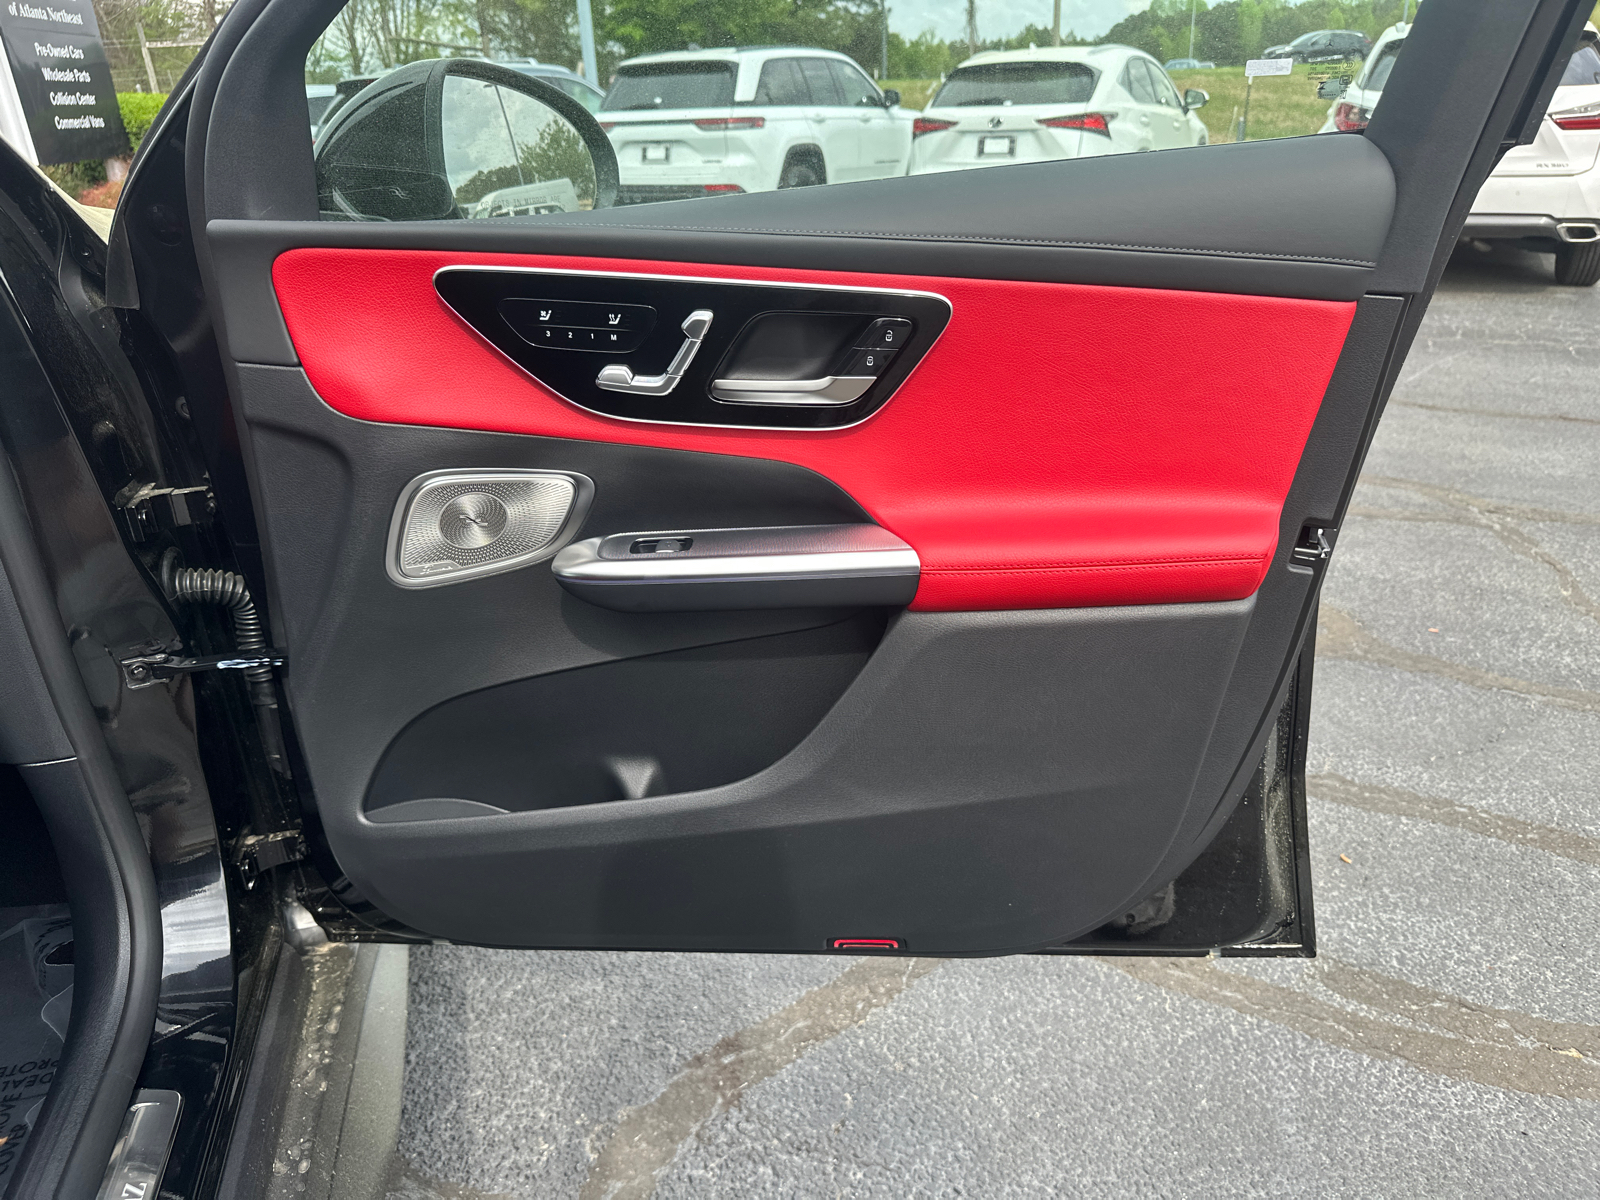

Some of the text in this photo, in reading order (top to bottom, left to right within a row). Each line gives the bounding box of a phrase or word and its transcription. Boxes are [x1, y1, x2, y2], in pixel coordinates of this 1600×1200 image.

[8, 2, 83, 25] of Atlanta Northeast
[34, 42, 84, 60] Pre-Owned Cars
[41, 67, 91, 83] Wholesale Parts
[49, 91, 96, 106] Collision Center
[54, 114, 105, 130] Commercial Vans
[480, 199, 510, 209] OBJECTS
